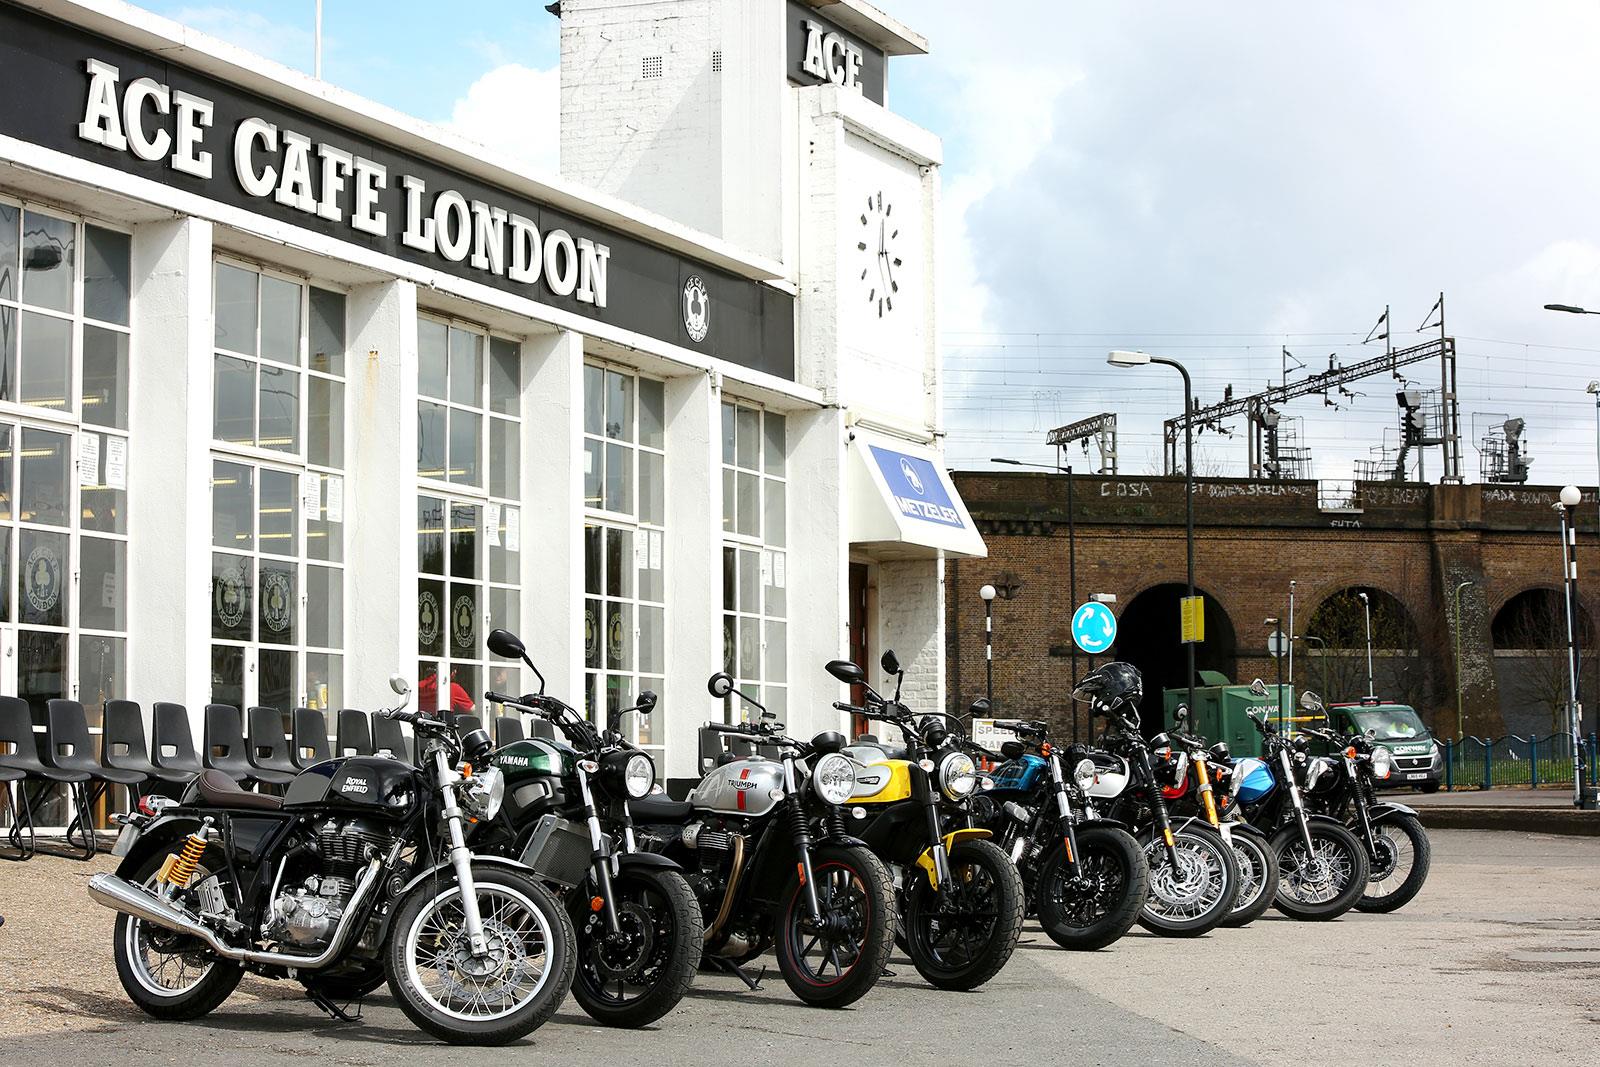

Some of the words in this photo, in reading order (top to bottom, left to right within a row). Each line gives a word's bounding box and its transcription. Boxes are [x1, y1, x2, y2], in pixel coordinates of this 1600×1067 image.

[803, 19, 863, 94] ACE
[78, 57, 214, 179] ACE
[234, 117, 387, 237] CAFE
[402, 174, 610, 308] LONDON
[895, 495, 962, 525] METZELER
[29, 589, 58, 610] LONDON
[1245, 705, 1280, 714] CONWA
[500, 755, 528, 766] YAMAHA
[345, 776, 367, 785] ROYAL
[728, 779, 757, 790] TRIUMPH
[341, 785, 368, 794] ENFIELD
